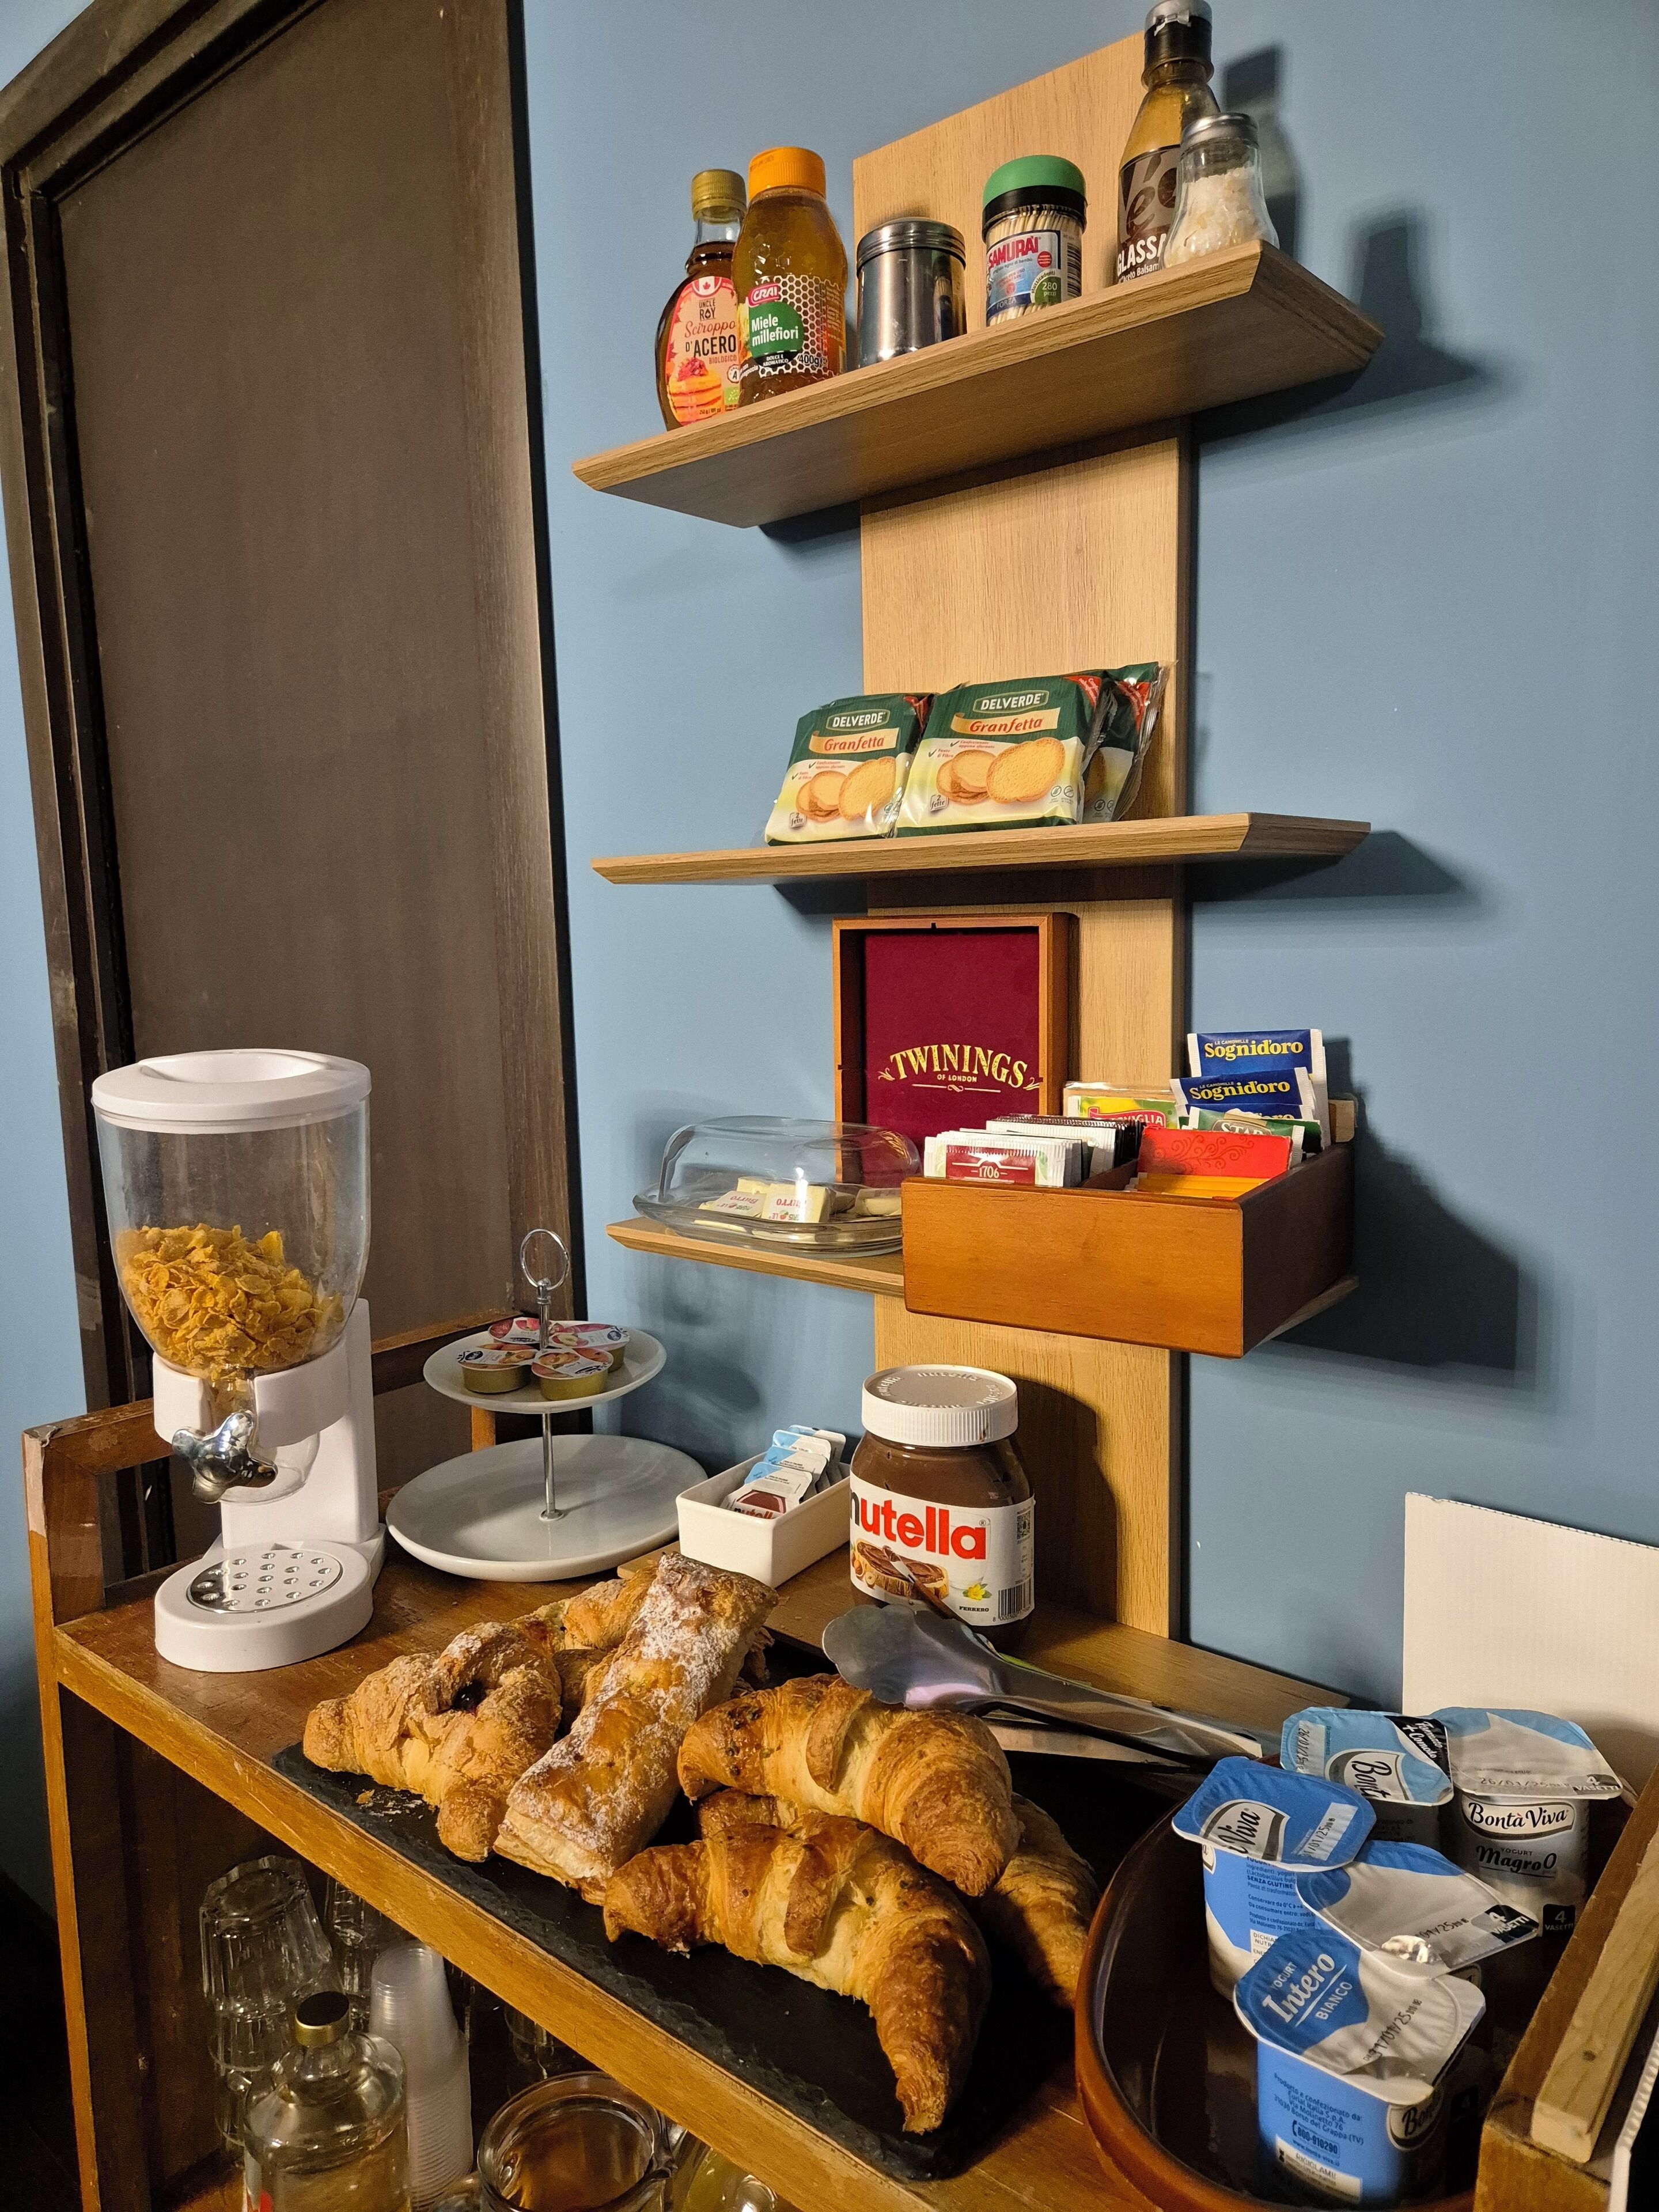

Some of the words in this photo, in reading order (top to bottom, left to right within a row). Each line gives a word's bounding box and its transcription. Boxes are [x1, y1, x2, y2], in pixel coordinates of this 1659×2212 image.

[753, 286, 778, 301] CRAI
[1042, 282, 1057, 290] 280
[699, 299, 715, 309] UNCLE
[997, 297, 1016, 309] FORZA
[699, 306, 716, 320] ROY
[684, 320, 737, 338] Sciroppo
[752, 314, 778, 332] Miele
[752, 326, 798, 347] millefiori
[709, 354, 737, 364] BIOLOGICO
[799, 354, 819, 367] 400g
[980, 695, 1041, 710] DELVERDE
[832, 713, 883, 728] DELVERDE
[969, 717, 1044, 733] Granfetta
[824, 736, 885, 751] Granfetta
[931, 800, 945, 810] fette
[791, 818, 804, 826] fette
[890, 1044, 1028, 1088] TWININGS
[948, 1074, 977, 1082] LONDON
[979, 1166, 999, 1179] 1706
[730, 1195, 759, 1204] Burro
[850, 1488, 987, 1560] nutella
[1408, 1732, 1437, 1759] Comodo
[1468, 1802, 1525, 1830] Bontà
[1526, 1807, 1567, 1828] Viva
[1217, 1810, 1261, 1846] Viva
[1501, 1847, 1533, 1856] YOGURT
[1247, 1875, 1267, 1884] SENZA
[1267, 1880, 1293, 1889] GLUTINE
[1248, 1894, 1275, 1906] Conservare
[1256, 1904, 1283, 1914] consumare
[1555, 1910, 1566, 1923] 4
[1491, 1915, 1531, 1934] VASETTI
[1269, 1961, 1298, 1991] YOGURT
[1262, 1953, 1335, 2023] Intero
[1315, 1982, 1353, 2020] BIANCO
[1274, 2072, 1299, 2094] Prodotto
[1305, 2094, 1350, 2118] confezionato
[1289, 2099, 1298, 2109] Via
[1300, 2105, 1332, 2126] Molinetto
[1334, 2121, 1343, 2131] 76
[1306, 2102, 1324, 2115] Italia
[1291, 2107, 1309, 2123] Borso
[1310, 2119, 1320, 2128] del
[1322, 2124, 1347, 2139] Grappa
[1349, 2134, 1364, 2146] (TV)
[1297, 2127, 1338, 2154] 800-910290
